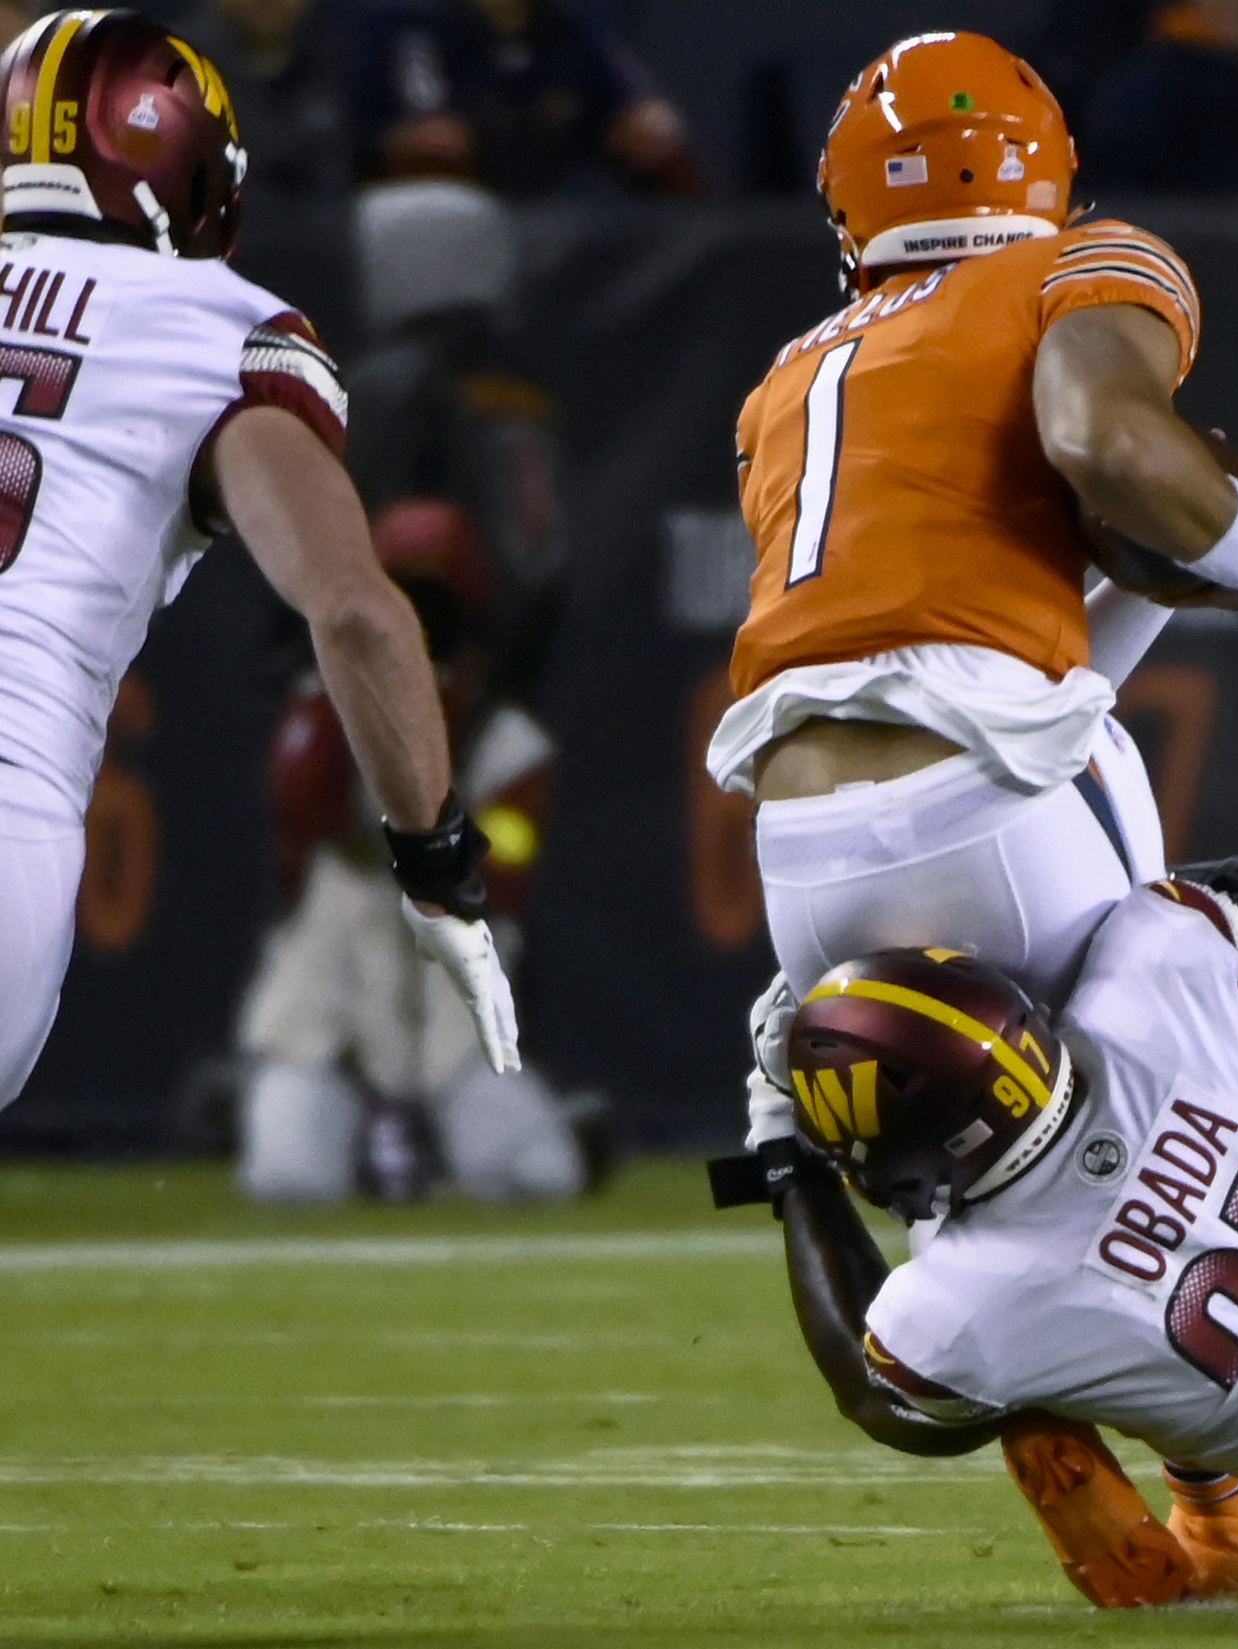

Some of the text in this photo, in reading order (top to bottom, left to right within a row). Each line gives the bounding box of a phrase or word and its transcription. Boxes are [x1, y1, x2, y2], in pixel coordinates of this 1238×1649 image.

[9, 101, 78, 154] 95
[903, 235, 968, 254] INSPIRE
[0, 262, 97, 346] HILL
[785, 335, 864, 591] 1
[993, 1030, 1050, 1118] 97
[1099, 1098, 1238, 1283] OBADA
